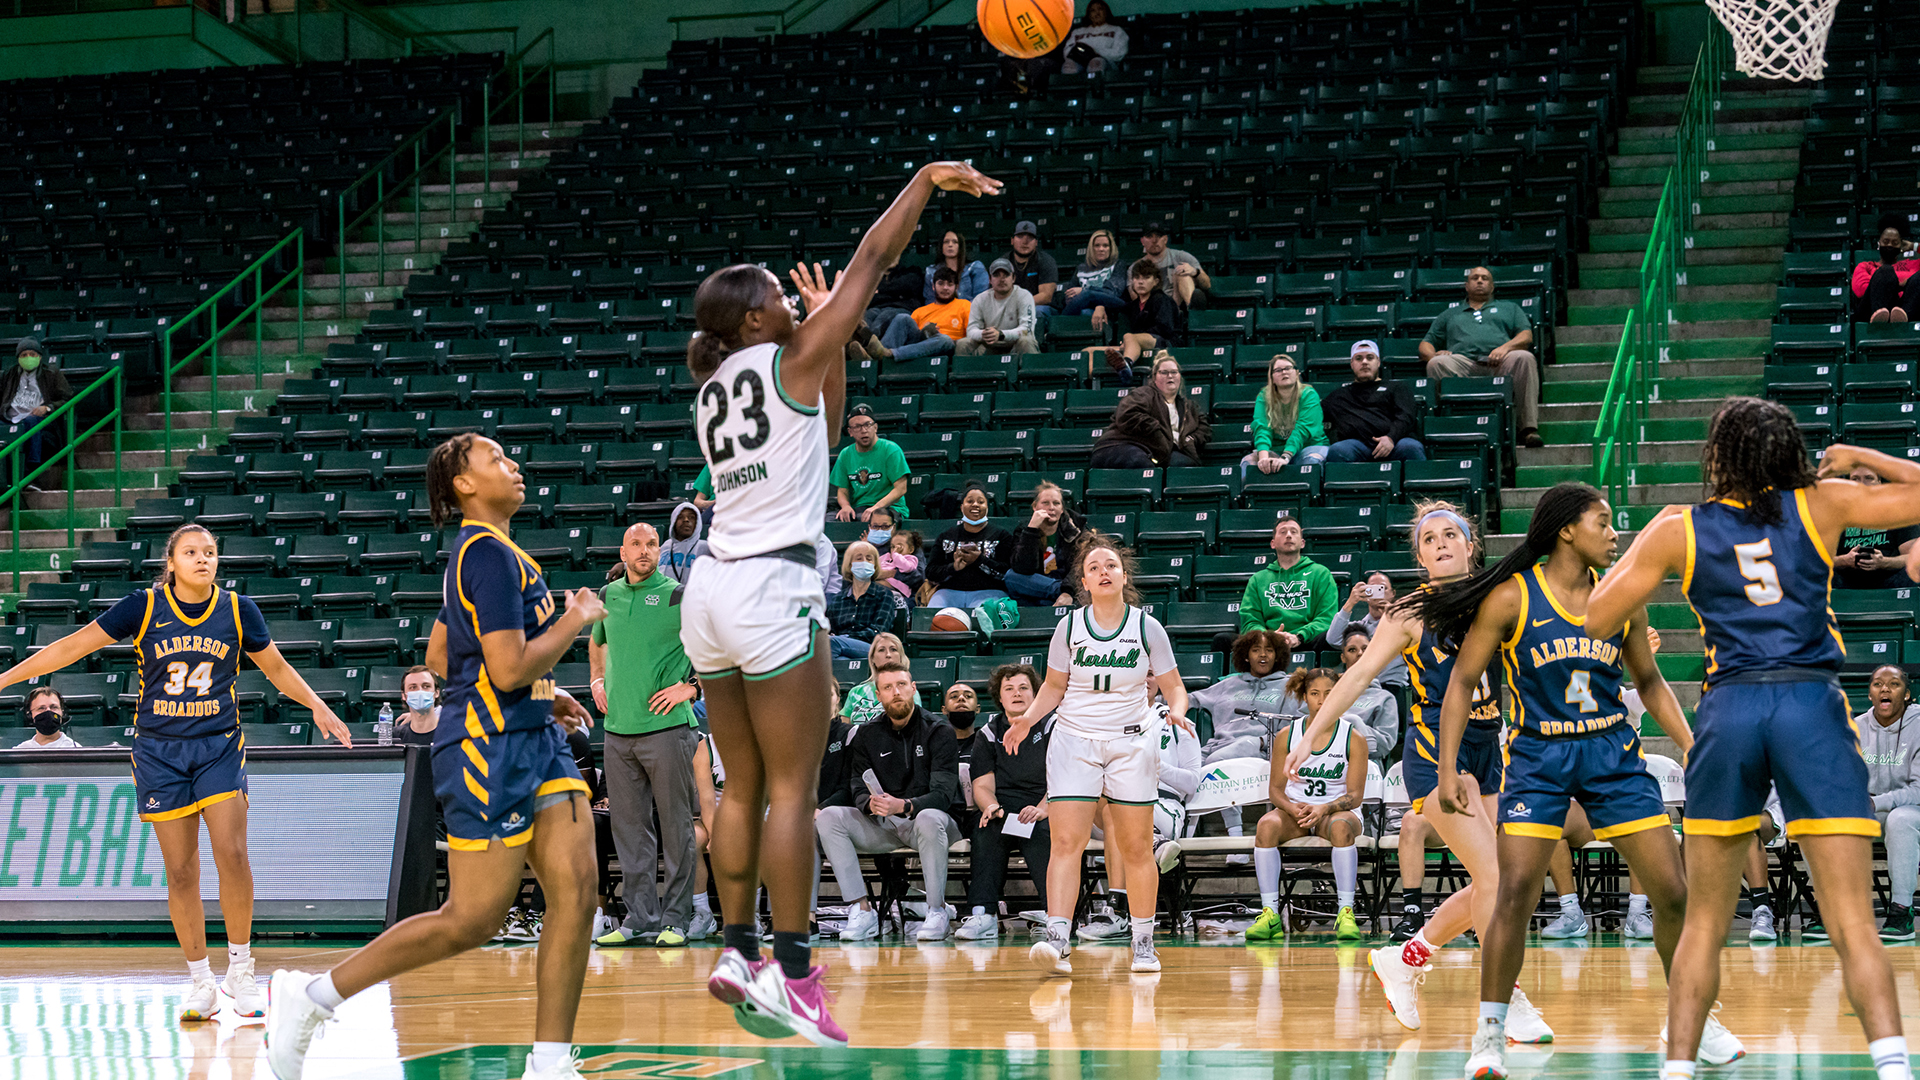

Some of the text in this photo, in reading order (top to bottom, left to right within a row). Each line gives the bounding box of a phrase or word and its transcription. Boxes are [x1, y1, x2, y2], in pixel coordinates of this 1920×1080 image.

[1017, 12, 1048, 51] ELITE
[1700, 170, 1709, 182] P
[1684, 237, 1694, 248] N
[1676, 272, 1687, 285] M
[365, 291, 374, 302] N
[1668, 309, 1677, 324] L
[326, 325, 338, 336] M
[1659, 347, 1670, 362] K
[286, 360, 295, 374] L
[1648, 384, 1659, 400] J
[244, 396, 254, 410] K
[702, 368, 770, 466] 23
[198, 434, 207, 449] J
[717, 461, 768, 493] JOHNSON
[100, 513, 110, 528] H
[1617, 511, 1629, 529] G
[50, 553, 60, 569] G
[1734, 538, 1783, 607] 5
[154, 636, 230, 660] ALDERSON
[1530, 637, 1618, 668] ALDERSON
[1073, 646, 1140, 668] Marshall
[163, 661, 214, 697] 34
[1094, 674, 1111, 692] 11
[1565, 669, 1598, 713] 4
[153, 699, 220, 717] BROADDUS
[1299, 762, 1345, 779] arshall
[1196, 774, 1269, 794] OUNTAIN HEALT
[1304, 780, 1327, 796] 33
[0, 784, 168, 887] ETBAL
